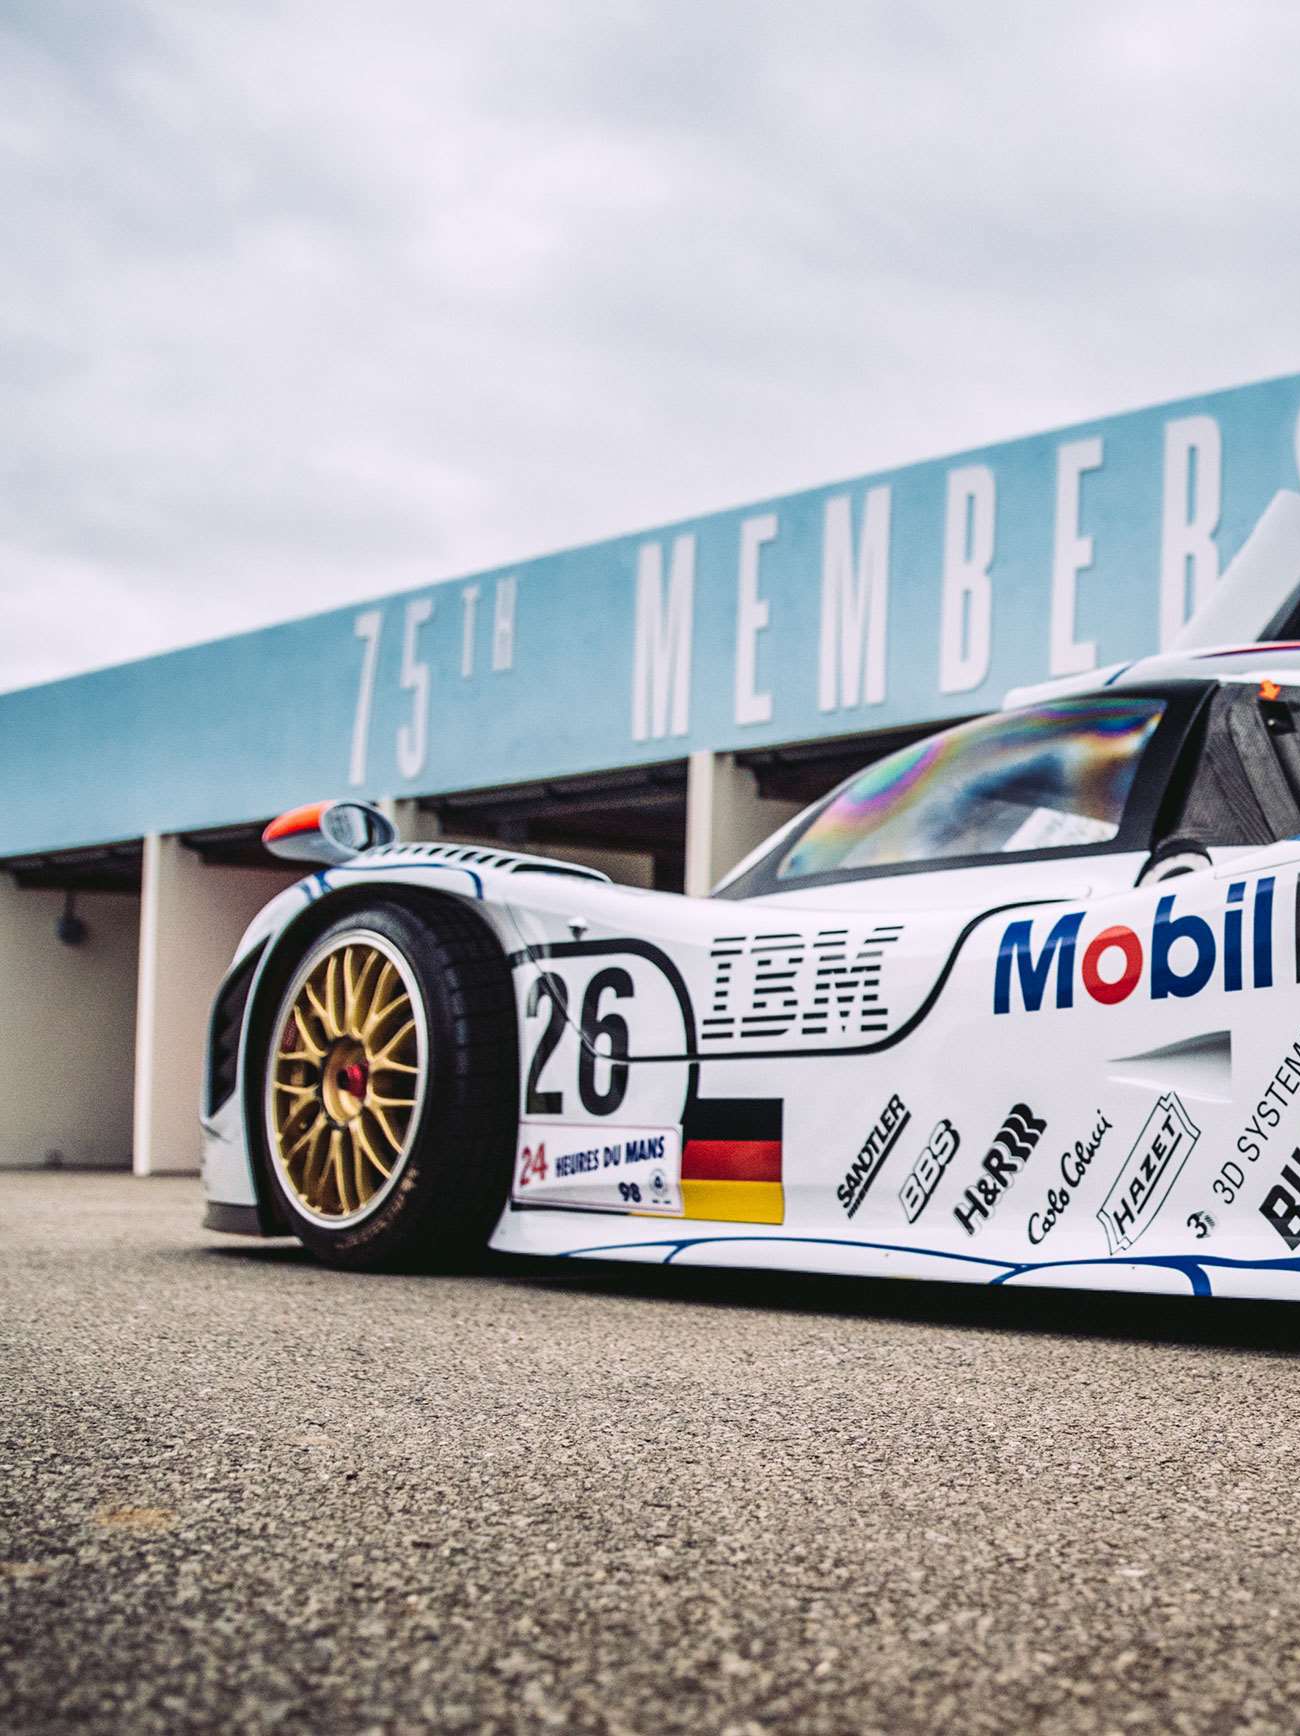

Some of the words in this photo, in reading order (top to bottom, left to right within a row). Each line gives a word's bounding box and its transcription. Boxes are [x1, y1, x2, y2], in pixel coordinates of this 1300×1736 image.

[701, 925, 904, 1039] IBM
[993, 875, 1276, 1015] Mobil
[525, 966, 635, 1117] 26
[520, 1142, 549, 1186] 24
[555, 1149, 600, 1178] HEURES
[603, 1143, 622, 1168] DU
[625, 1135, 665, 1164] MANS
[617, 1181, 642, 1203] 98
[837, 1093, 906, 1210] SANDTLER
[899, 1118, 961, 1224] BBS
[1060, 1108, 1113, 1188] Colucci
[1111, 1114, 1178, 1237] HAZET
[1212, 1161, 1245, 1205] 3D
